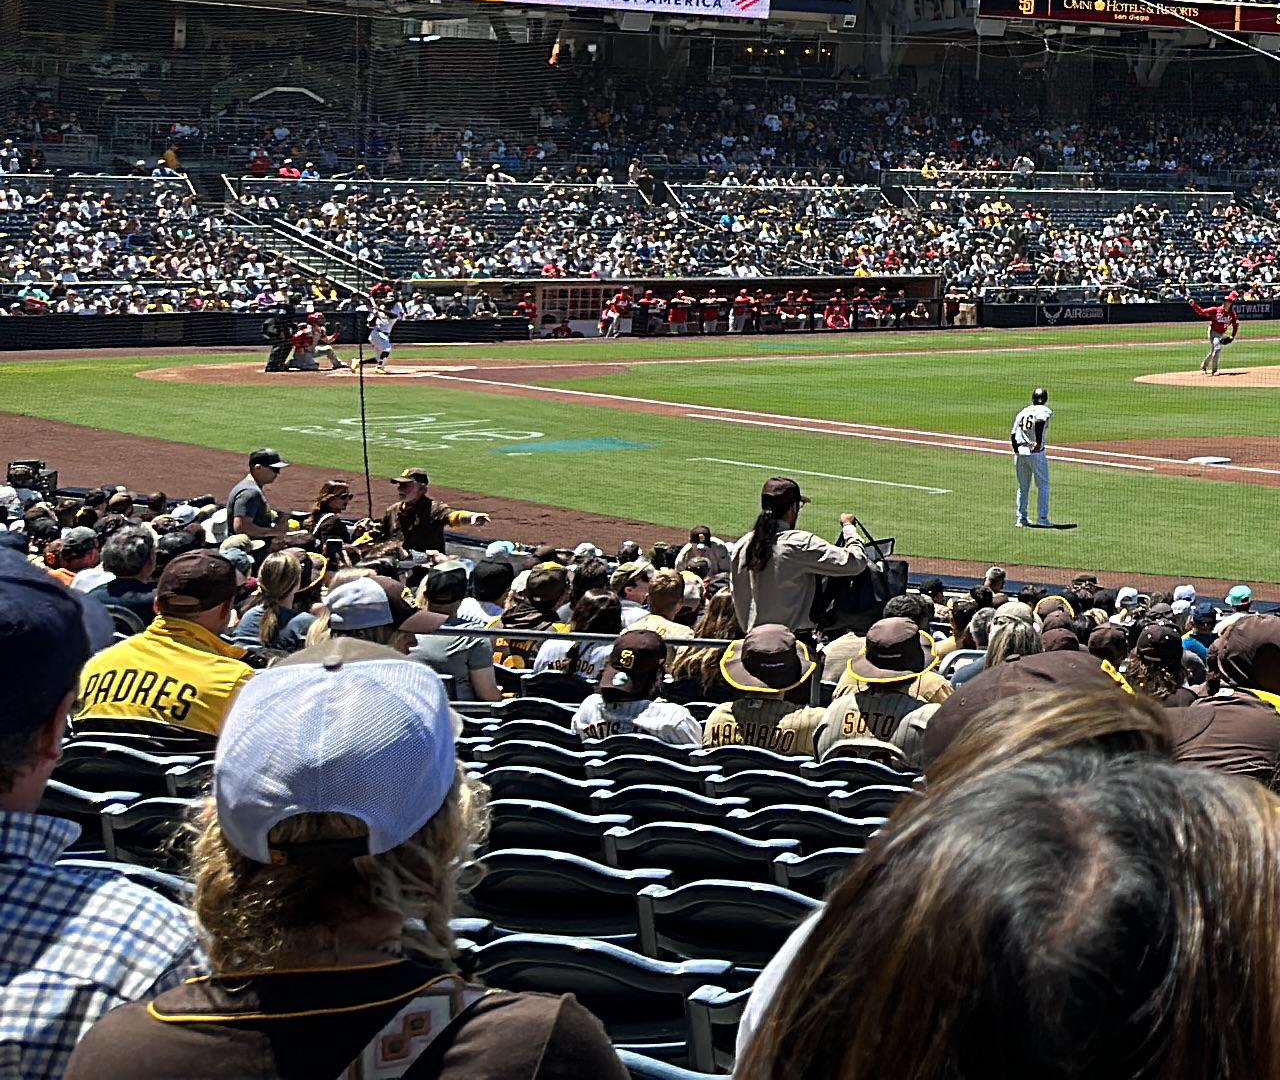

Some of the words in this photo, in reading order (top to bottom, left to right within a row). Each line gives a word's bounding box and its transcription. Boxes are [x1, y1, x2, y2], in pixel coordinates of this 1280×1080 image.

[1106, 0, 1145, 13] HOTELS
[1156, 3, 1198, 17] RESORTS
[83, 669, 198, 721] PADRES
[711, 722, 796, 753] MACHADO
[843, 712, 895, 742] SOTO
